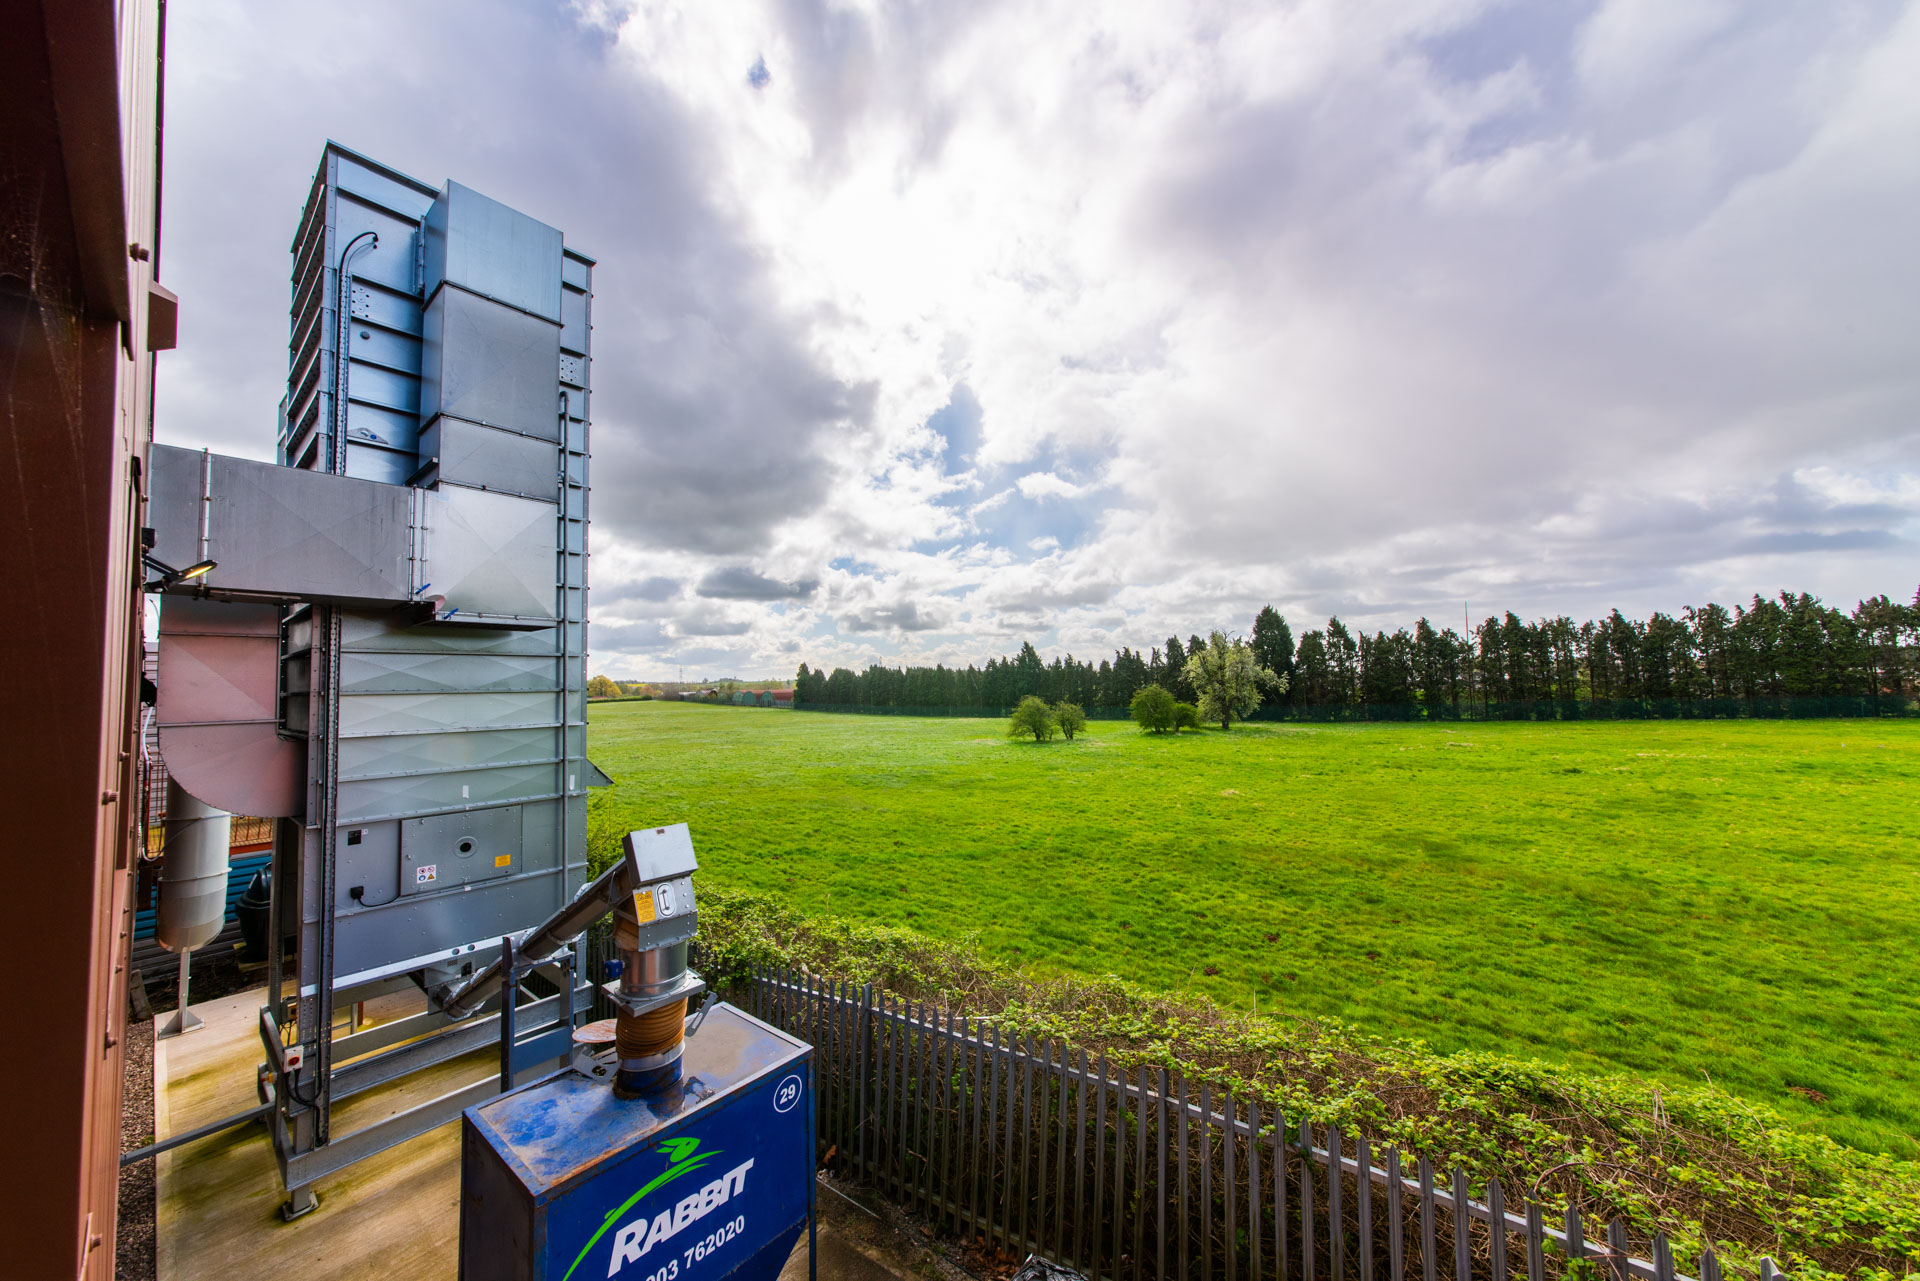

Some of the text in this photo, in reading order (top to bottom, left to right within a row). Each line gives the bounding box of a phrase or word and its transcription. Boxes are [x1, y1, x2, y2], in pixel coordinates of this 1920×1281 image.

[780, 1084, 796, 1104] 29
[607, 1157, 755, 1279] RABBIT
[683, 1215, 745, 1269] 762020
